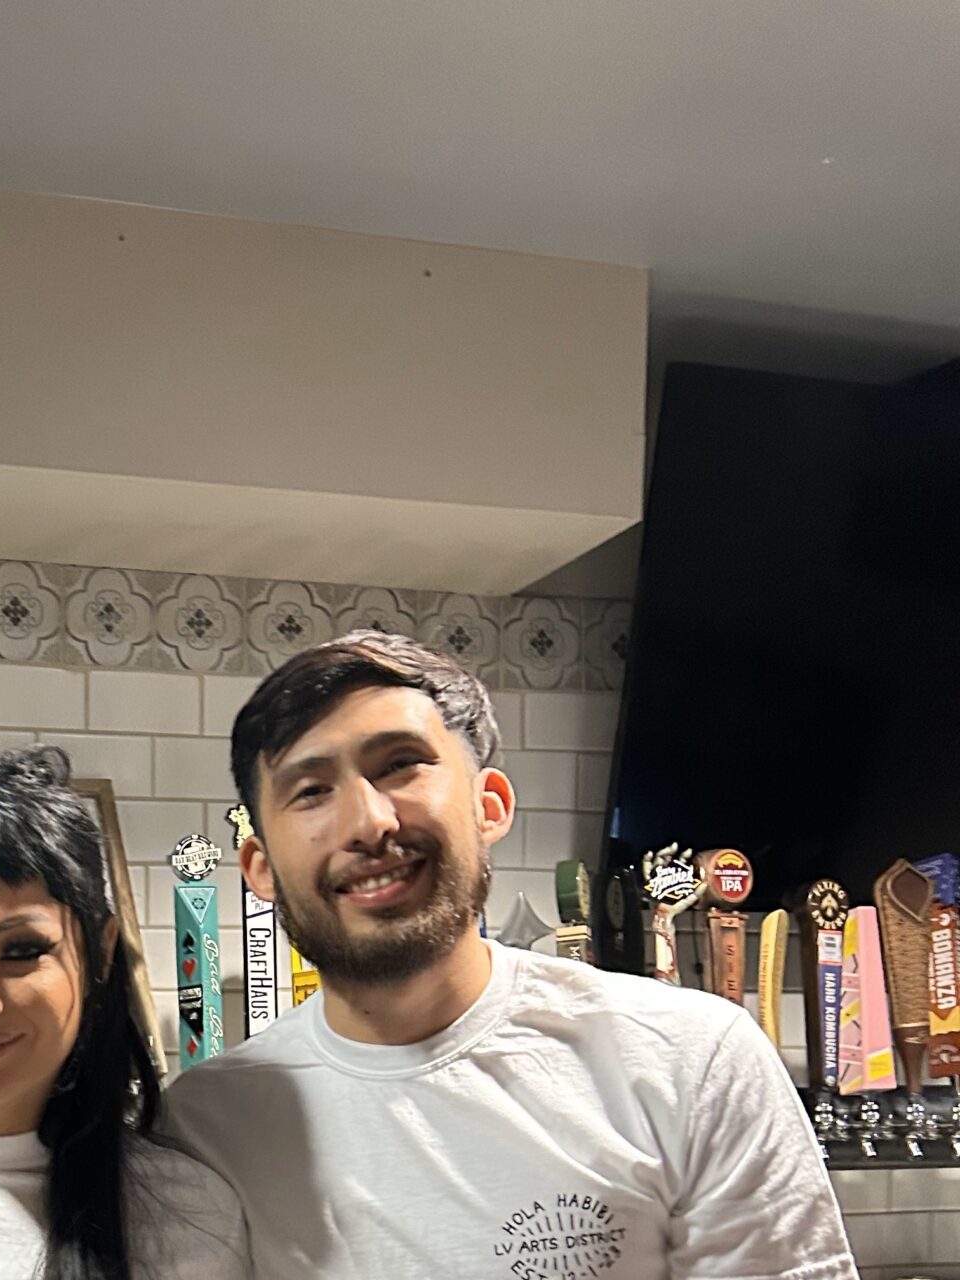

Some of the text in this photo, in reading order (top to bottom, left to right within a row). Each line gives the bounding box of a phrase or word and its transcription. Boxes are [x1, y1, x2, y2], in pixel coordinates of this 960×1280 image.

[721, 880, 743, 892] IPA
[249, 927, 273, 1020] CRAFTHAUS
[932, 928, 958, 1010] BONANZA
[824, 972, 837, 1069] HARD KOMBUCHA
[493, 1227, 626, 1257] LV ARTS DISTRICT
[502, 1193, 614, 1236] HOLA HABIBI
